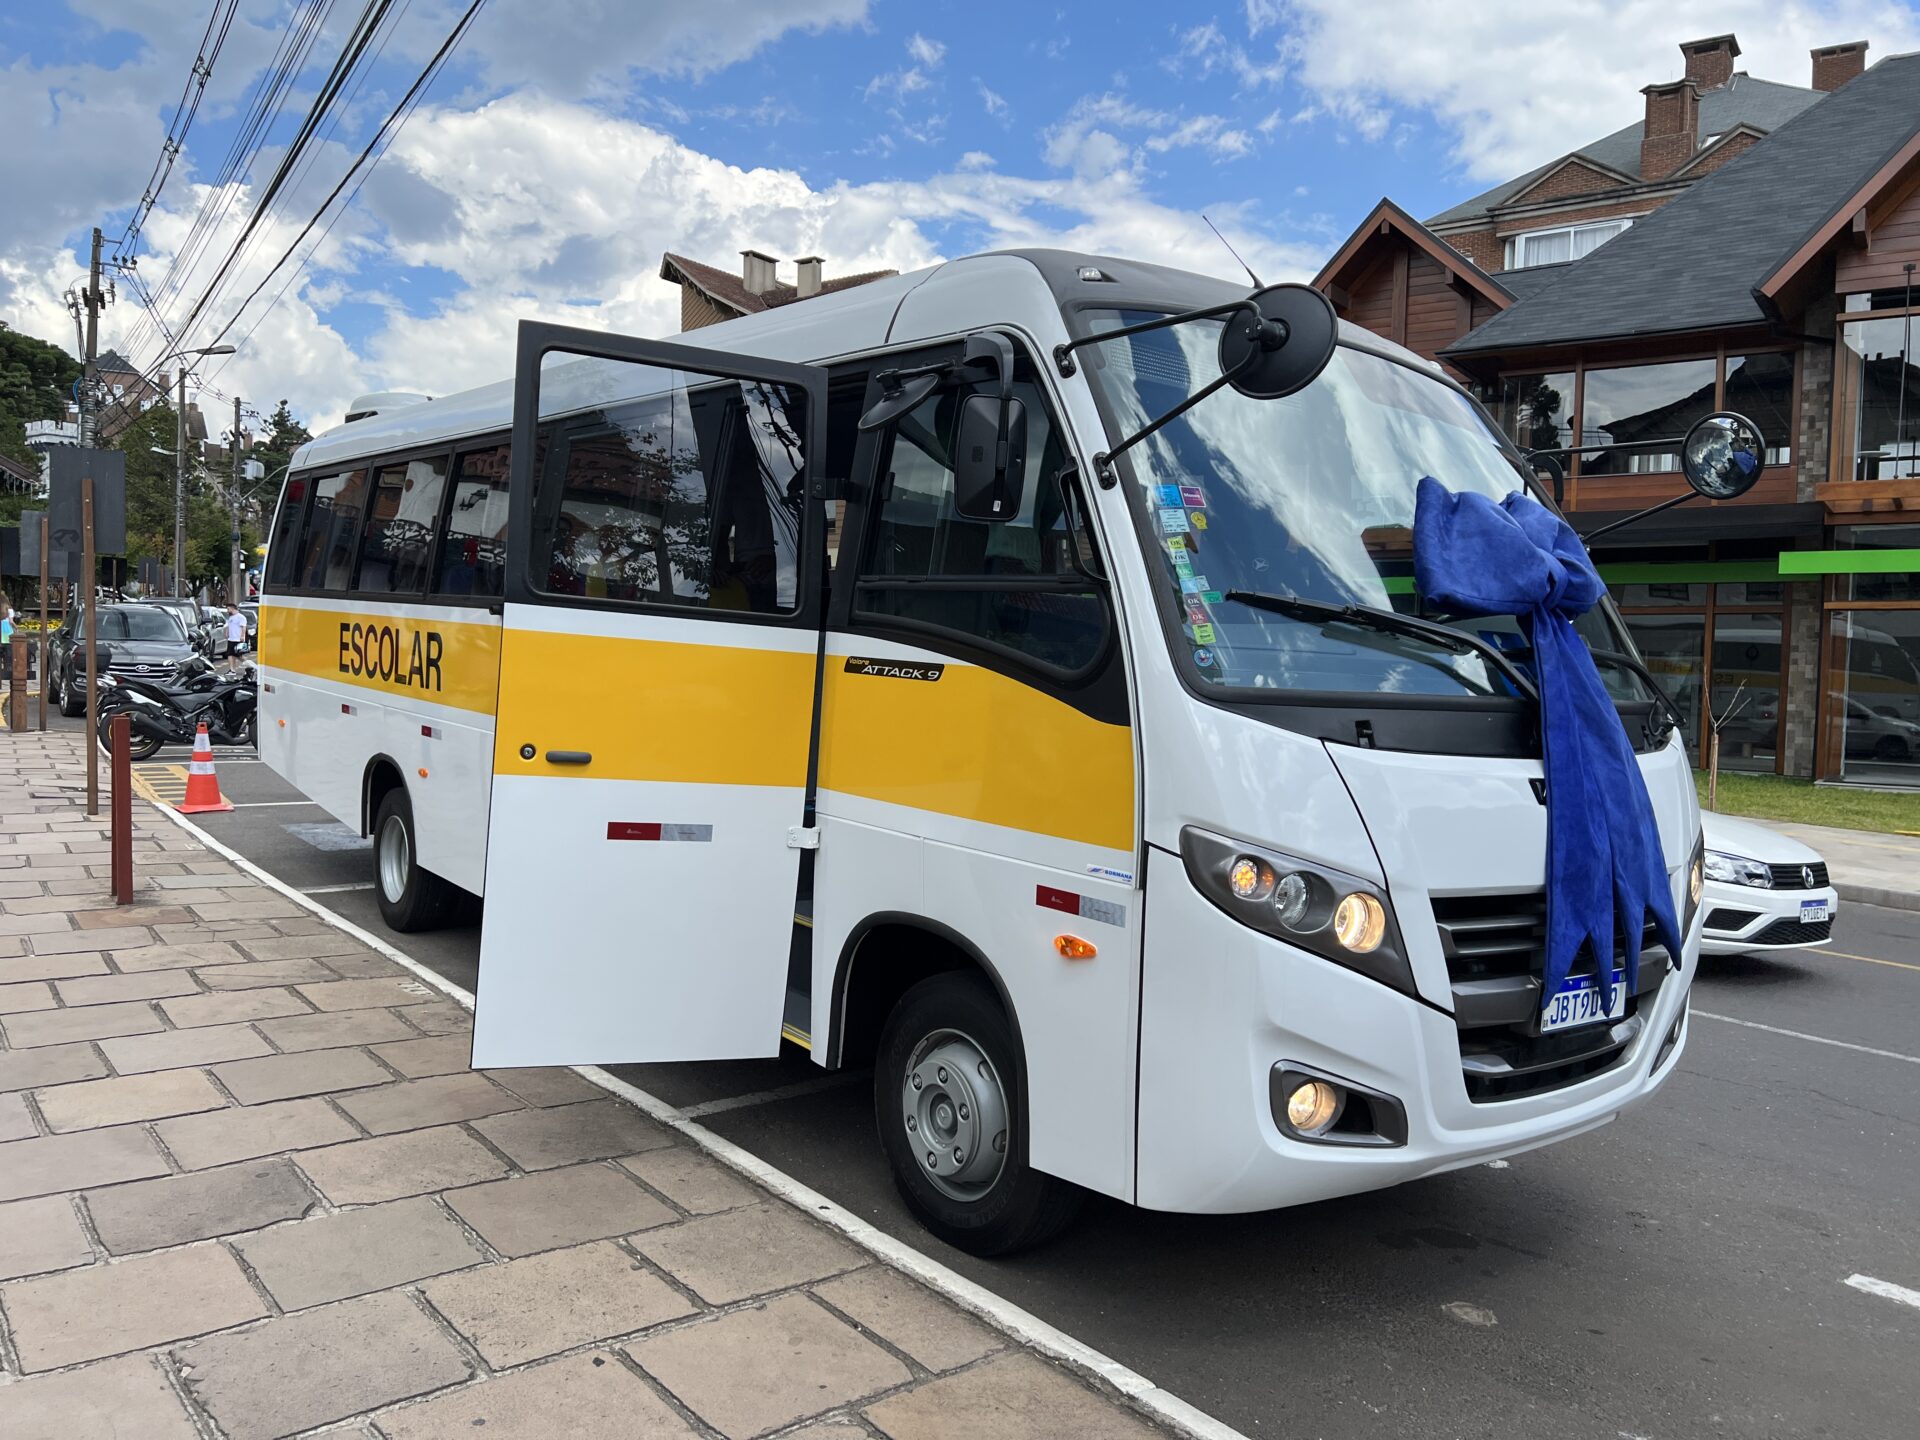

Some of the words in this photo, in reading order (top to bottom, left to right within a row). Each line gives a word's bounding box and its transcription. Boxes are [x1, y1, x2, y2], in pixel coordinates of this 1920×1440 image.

[339, 622, 443, 692] ESCOLAR
[861, 665, 925, 679] ATTACK
[927, 670, 940, 680] 9
[1550, 986, 1618, 1025] JBT9D9
